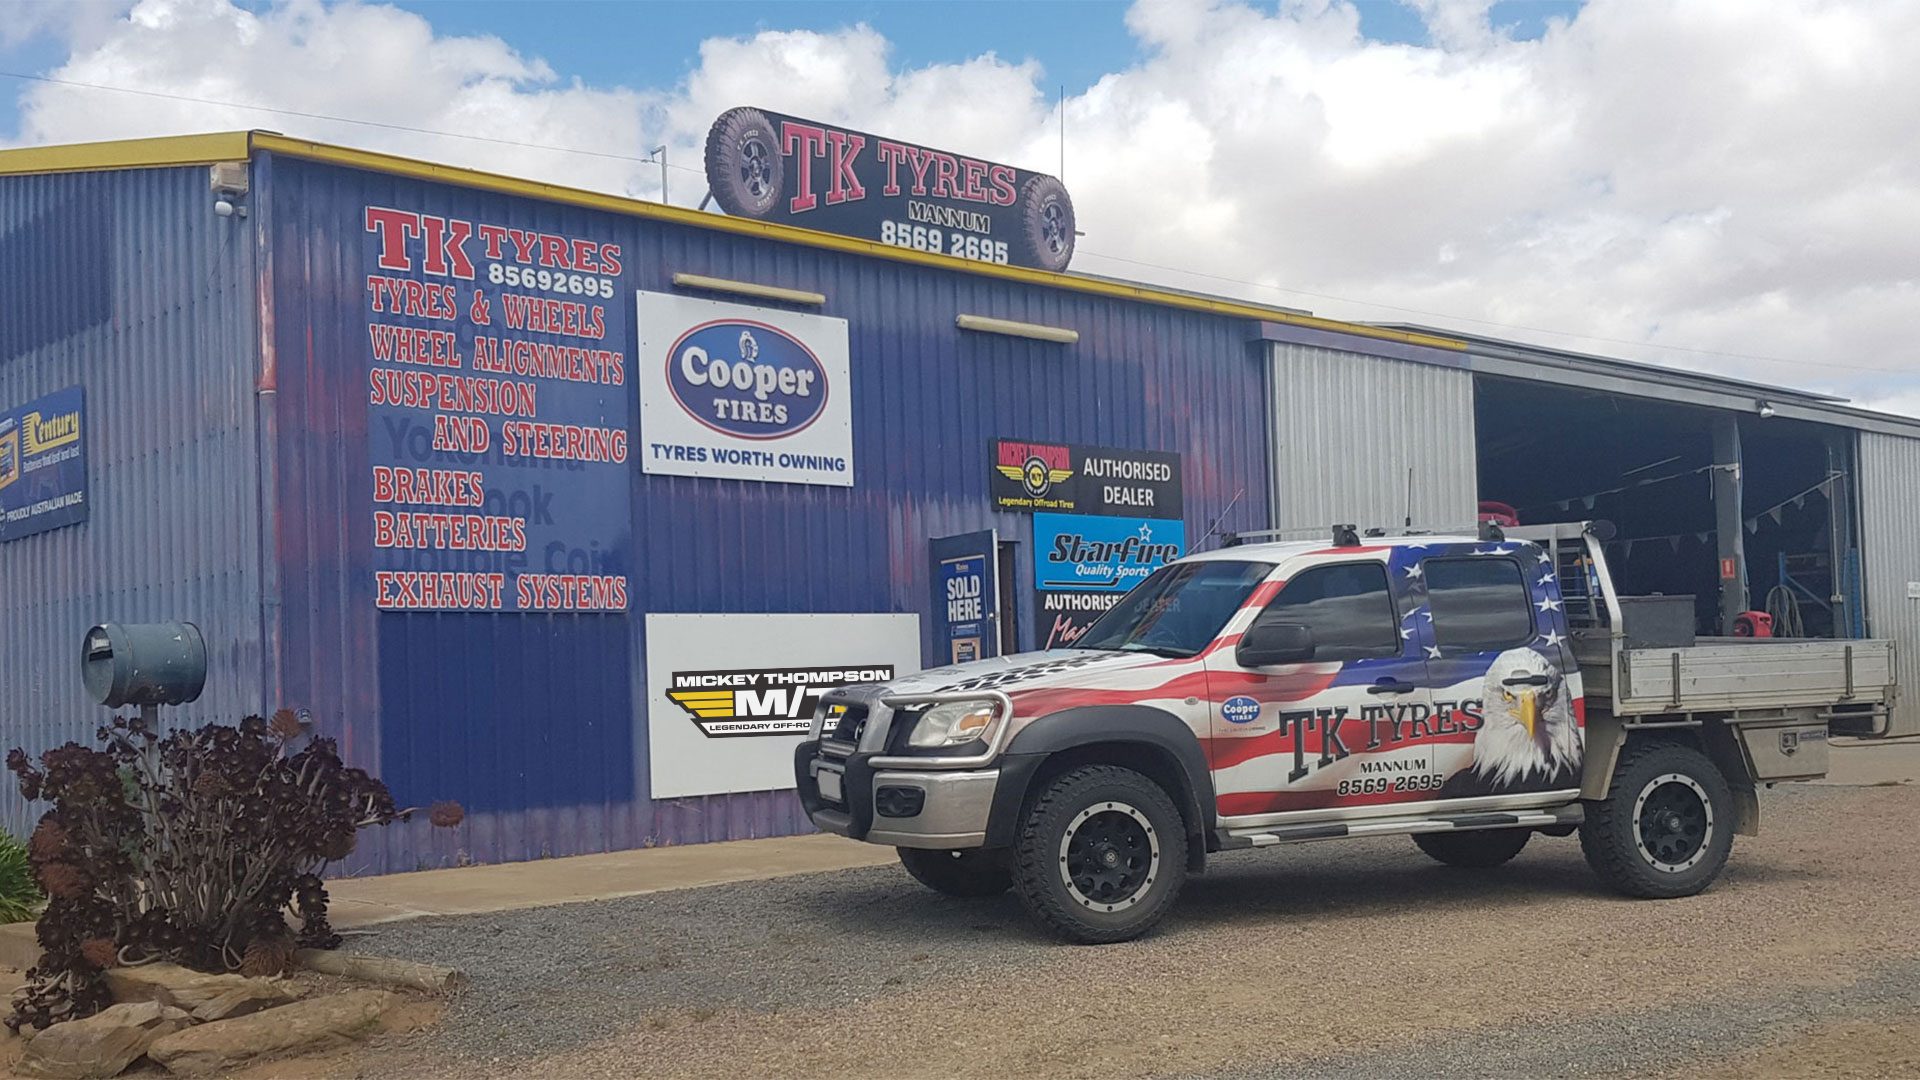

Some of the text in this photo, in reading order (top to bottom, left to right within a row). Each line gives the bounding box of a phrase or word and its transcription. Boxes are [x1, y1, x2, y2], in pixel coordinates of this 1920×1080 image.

[780, 121, 1018, 214] TK TYRES
[908, 200, 991, 234] MANNUM
[365, 205, 475, 280] TK
[478, 223, 622, 276] TYRES
[881, 219, 1009, 265] 8569 2695
[488, 262, 614, 299] 85692695
[367, 274, 457, 321] TYRES
[470, 289, 491, 326] &
[502, 292, 605, 340] WHEELS
[369, 323, 462, 369] WHEEL
[472, 335, 625, 386] ALIGNMENTS
[680, 345, 816, 402] Cooper
[370, 366, 537, 418] SUSPENSION
[712, 397, 789, 426] TIRES
[22, 411, 79, 457] Century
[432, 413, 491, 454] AND
[503, 420, 628, 465] STEERING
[650, 442, 847, 474] TYRES WORTH OWNING
[1083, 457, 1171, 483] AUTHORISED
[373, 465, 486, 508] BRAKES
[998, 496, 1074, 509] Legendary Offroad Tires
[1103, 486, 1154, 508] DEALER
[6, 491, 82, 523] PROUDLY AUSTRALIAN MADE
[374, 510, 527, 553] BATTERIES
[1049, 533, 1180, 565] Starfire
[1075, 563, 1149, 579] Quality Sports
[375, 570, 628, 611] EXHAUST SYSTEMS
[946, 575, 980, 600] SOLD
[1044, 594, 1124, 611] AUTHORISE
[947, 598, 982, 622] HERE
[676, 669, 890, 688] MICKEY THOMPSON
[1223, 703, 1259, 715] Cooper
[709, 721, 811, 731] LEGENDARY OFF-RO
[1278, 698, 1486, 784] TK TYRES
[1360, 758, 1427, 774] MANNUM
[1337, 773, 1444, 796] 8569 2695
